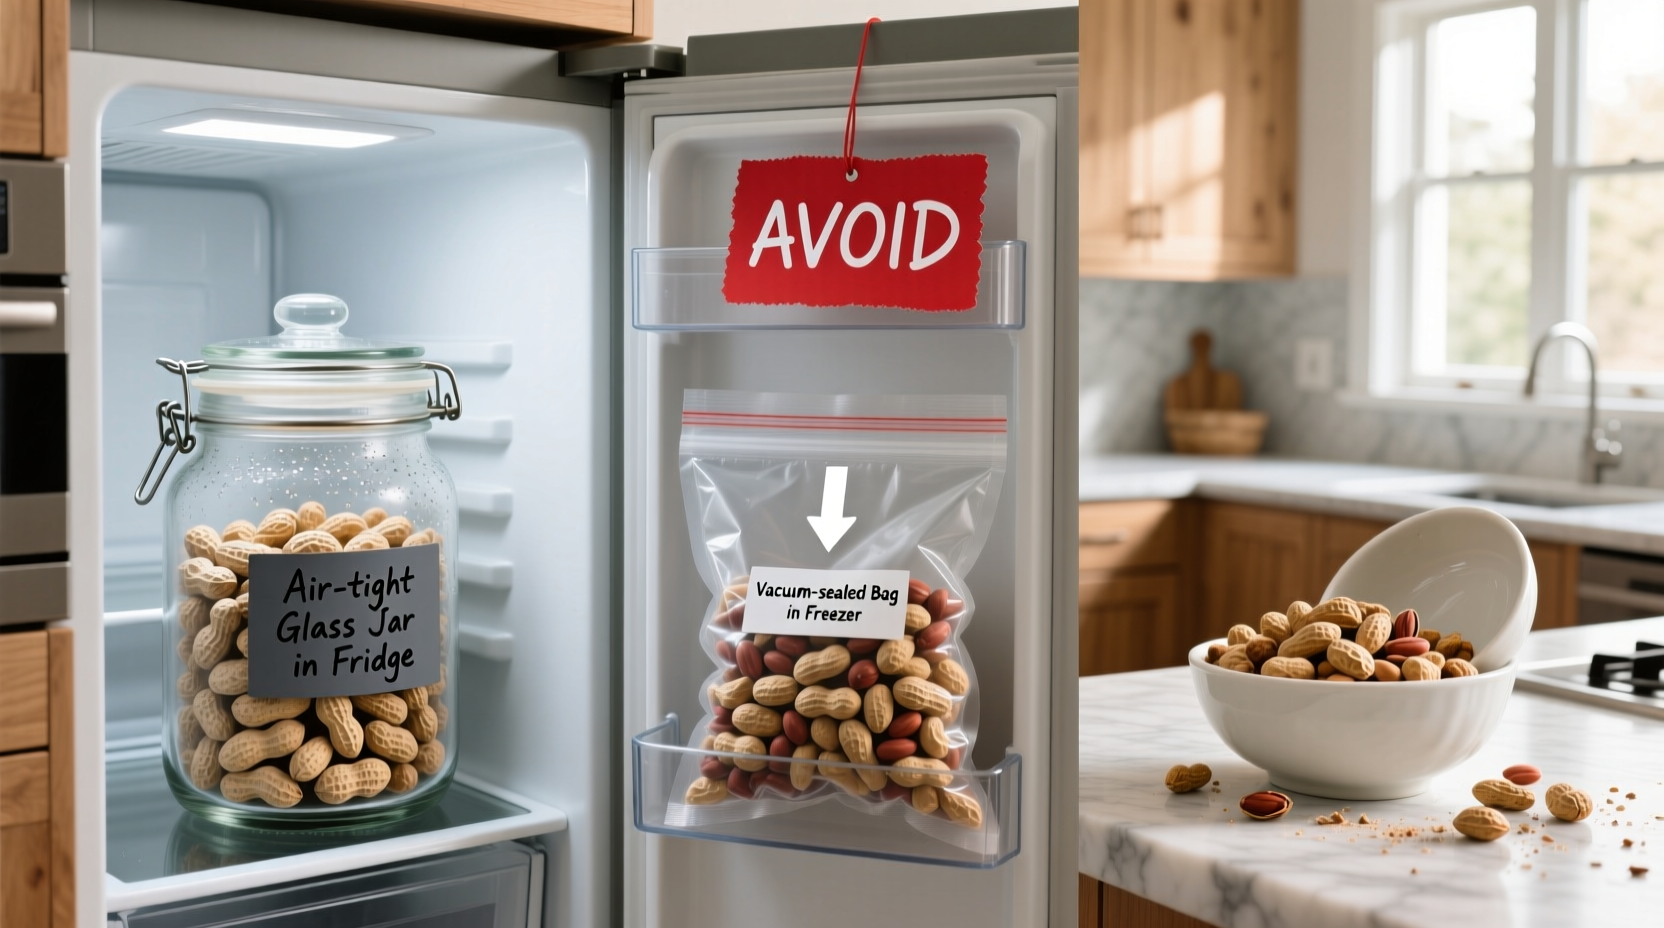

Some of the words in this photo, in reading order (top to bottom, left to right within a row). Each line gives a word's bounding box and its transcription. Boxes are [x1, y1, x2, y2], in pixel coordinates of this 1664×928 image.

[749, 199, 960, 271] AVOID
[283, 566, 415, 612] Air-tight
[870, 585, 899, 606] Bag
[276, 610, 356, 644] Glass
[368, 606, 415, 637] Jar
[786, 604, 800, 620] in
[805, 605, 862, 622] Freezer
[293, 653, 318, 678] in
[332, 642, 415, 683] Fridge
